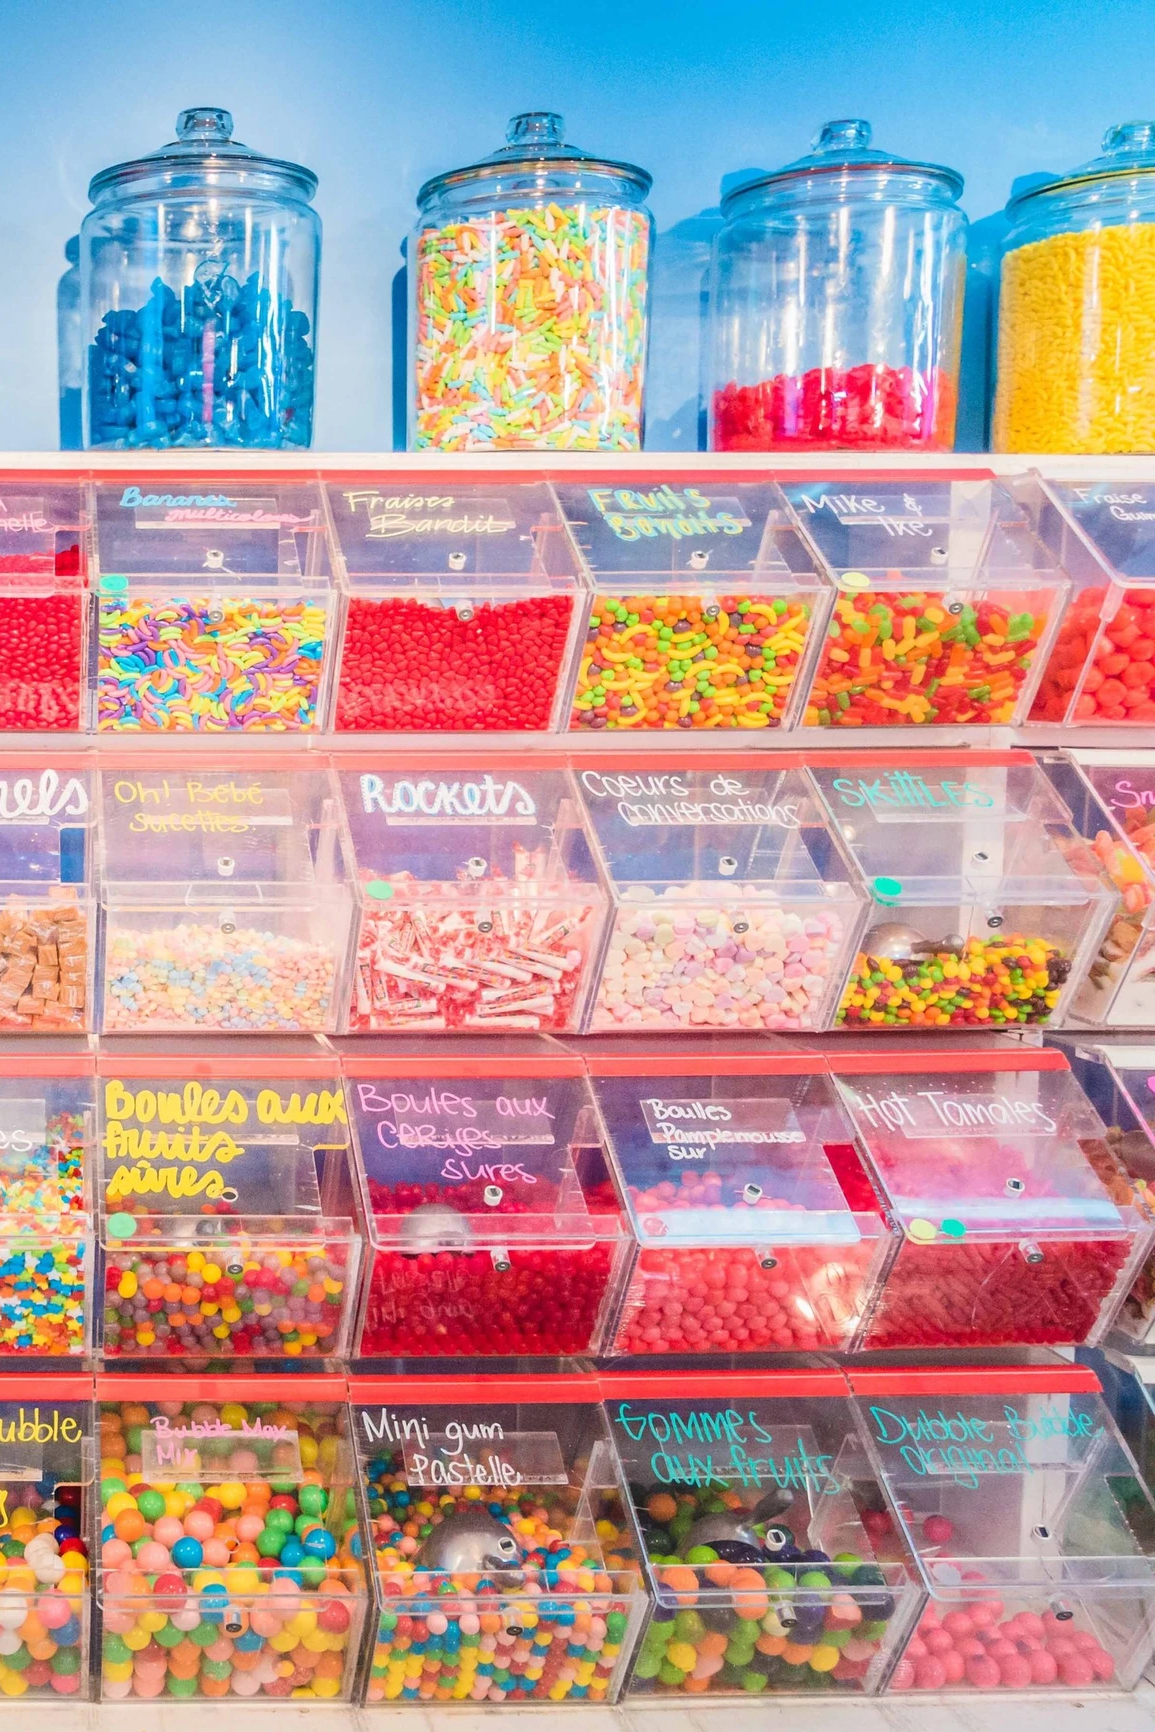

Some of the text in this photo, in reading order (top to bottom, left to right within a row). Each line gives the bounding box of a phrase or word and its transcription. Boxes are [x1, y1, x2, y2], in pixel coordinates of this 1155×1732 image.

[119, 486, 237, 507] Bananes
[800, 494, 885, 513] Mike
[1075, 487, 1147, 504] Fraise
[365, 513, 513, 538] Bandit
[876, 515, 933, 537] Ike
[113, 779, 171, 807] Oh!
[359, 773, 537, 817] Rockets
[581, 770, 750, 797] Coeurs de
[104, 1079, 349, 1125] Boules aux
[356, 1083, 556, 1120] Boules aux
[646, 1099, 732, 1121] Boulles
[855, 1089, 1058, 1135] Hot Tamales
[101, 1120, 246, 1164] fruits
[361, 1407, 505, 1457] Mini gum
[614, 1402, 773, 1445] Gommes
[869, 1404, 995, 1445] Dubble
[409, 1453, 523, 1489] Pastelle
[650, 1437, 841, 1496] aux fruits
